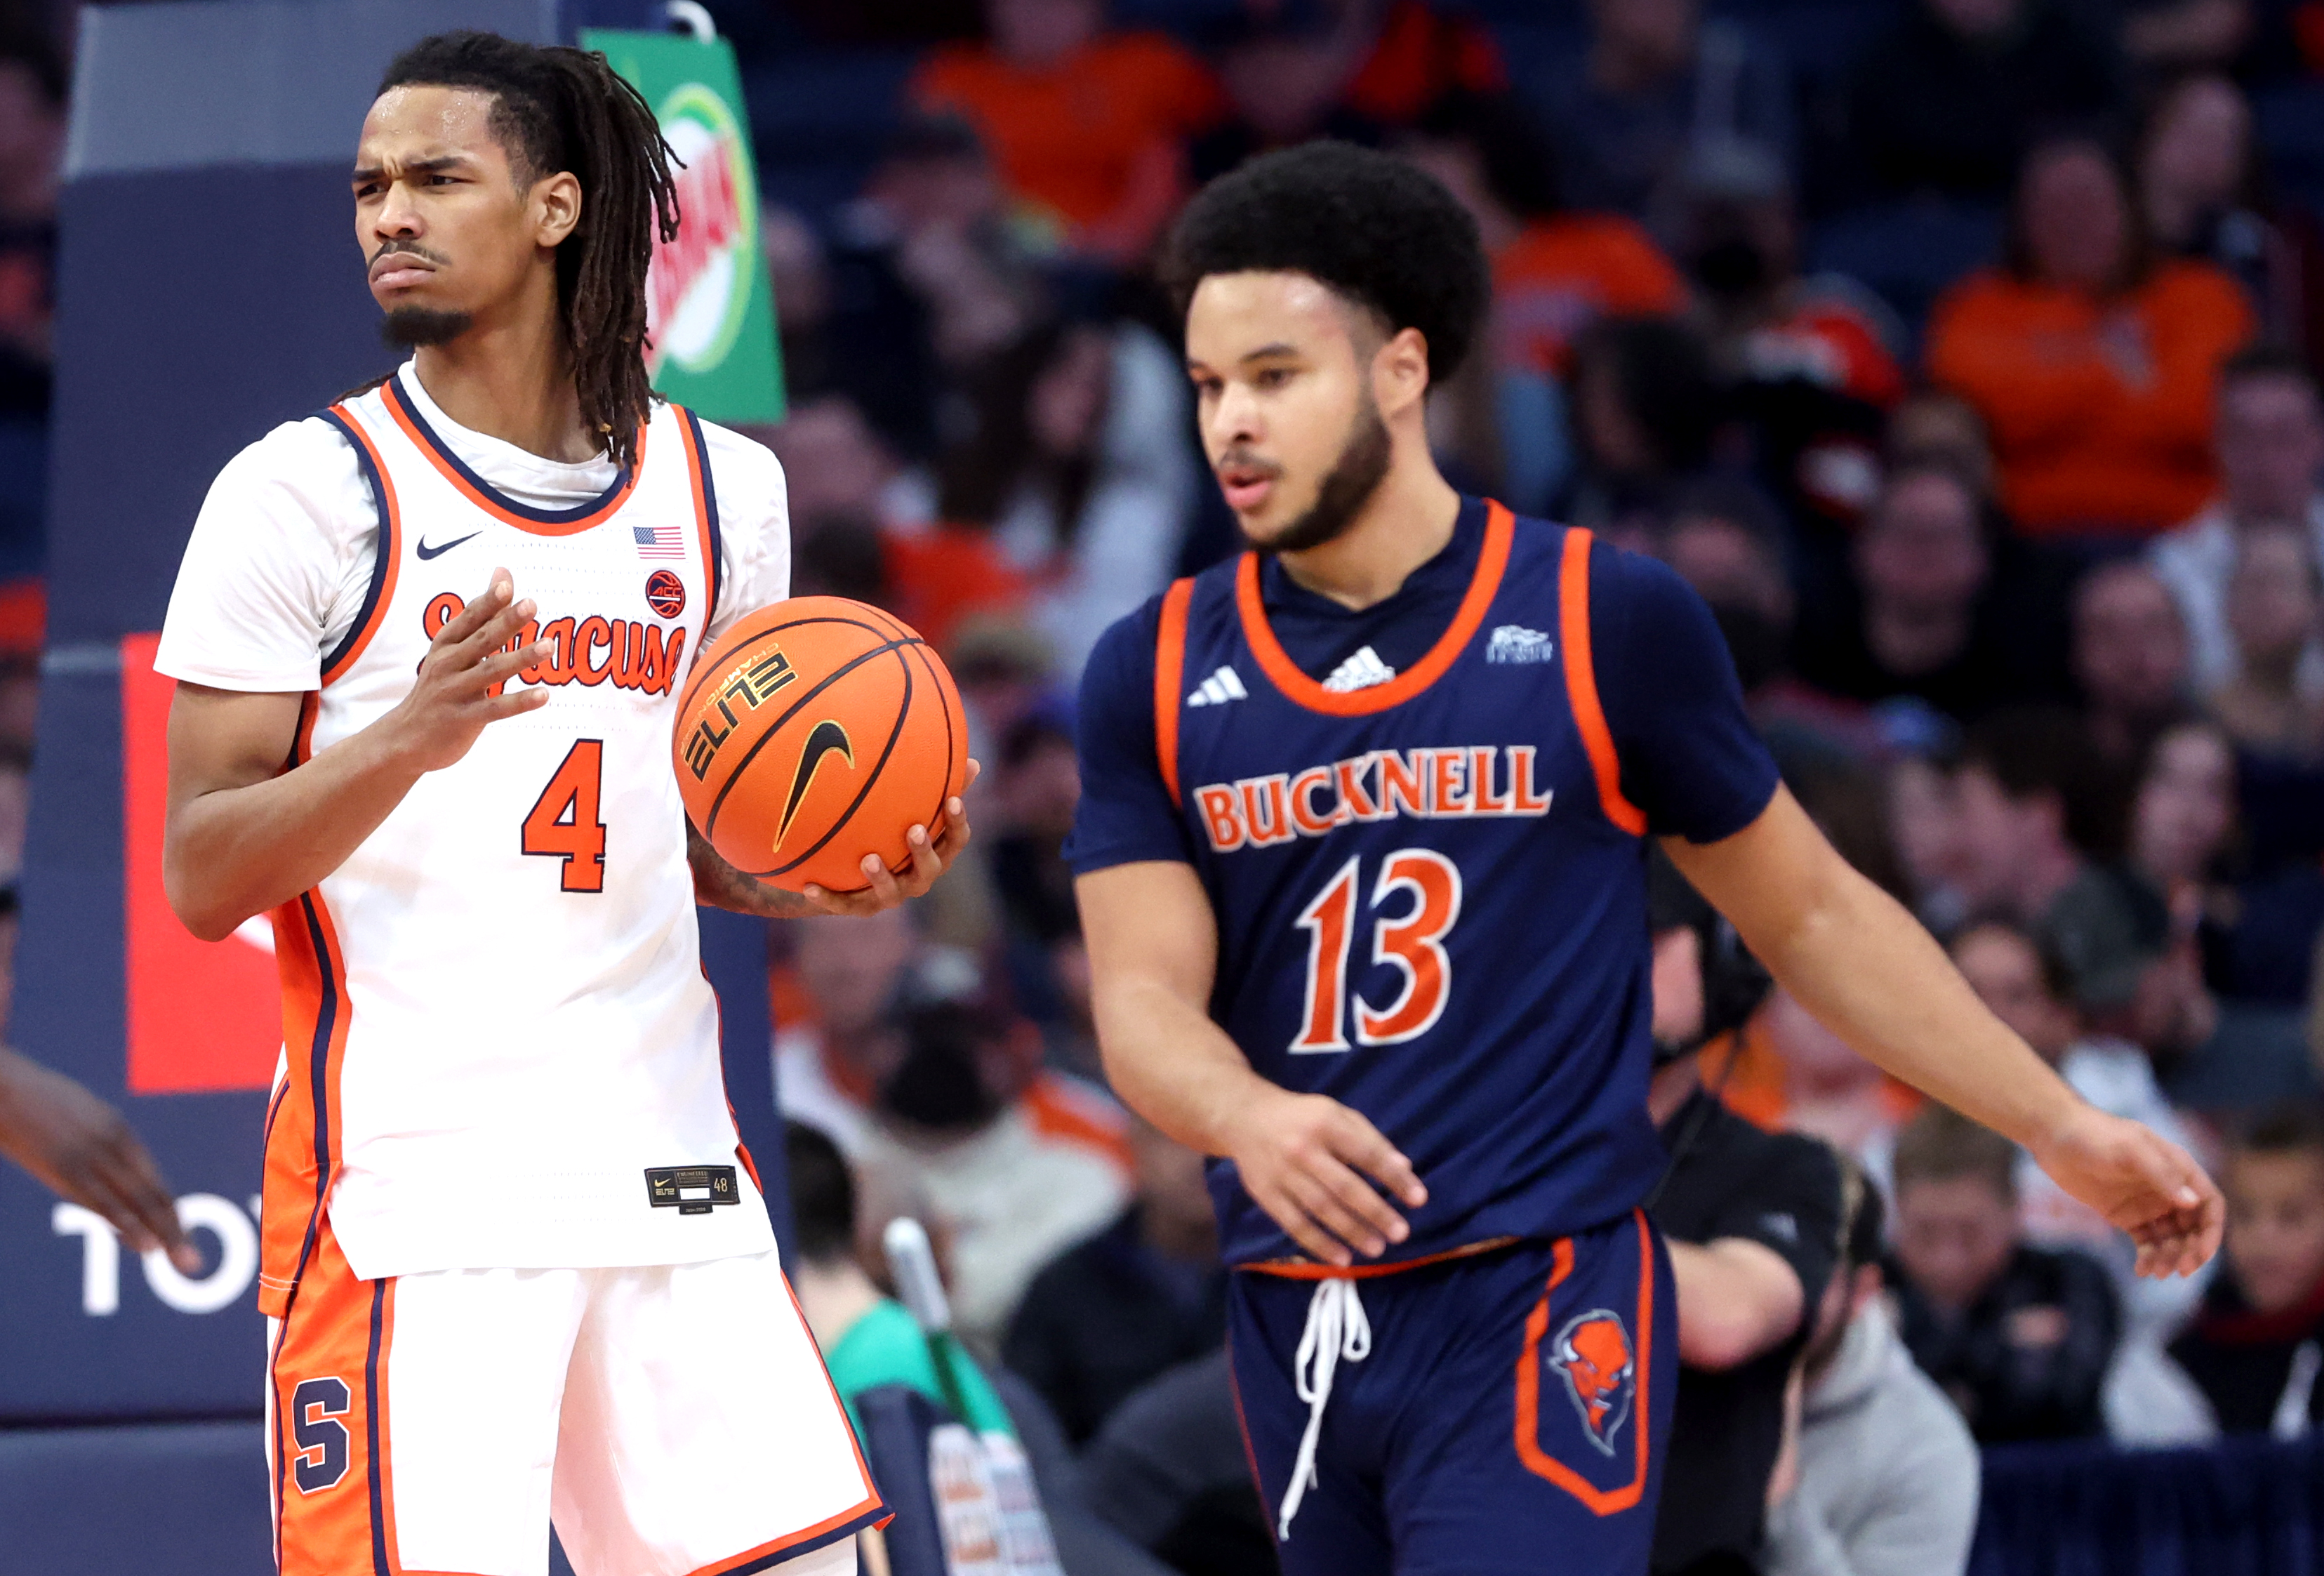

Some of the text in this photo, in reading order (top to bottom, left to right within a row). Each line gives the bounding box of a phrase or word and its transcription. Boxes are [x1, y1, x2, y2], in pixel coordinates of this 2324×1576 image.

[417, 592, 686, 697] racuse
[652, 586, 682, 597] ACC
[684, 650, 799, 785] ELITE
[521, 738, 606, 894] 4
[1193, 746, 1553, 852] BUCKNELL
[1287, 848, 1462, 1054] 13
[714, 1177, 728, 1193] 48
[51, 1192, 260, 1317] TO
[292, 1376, 350, 1495] S
